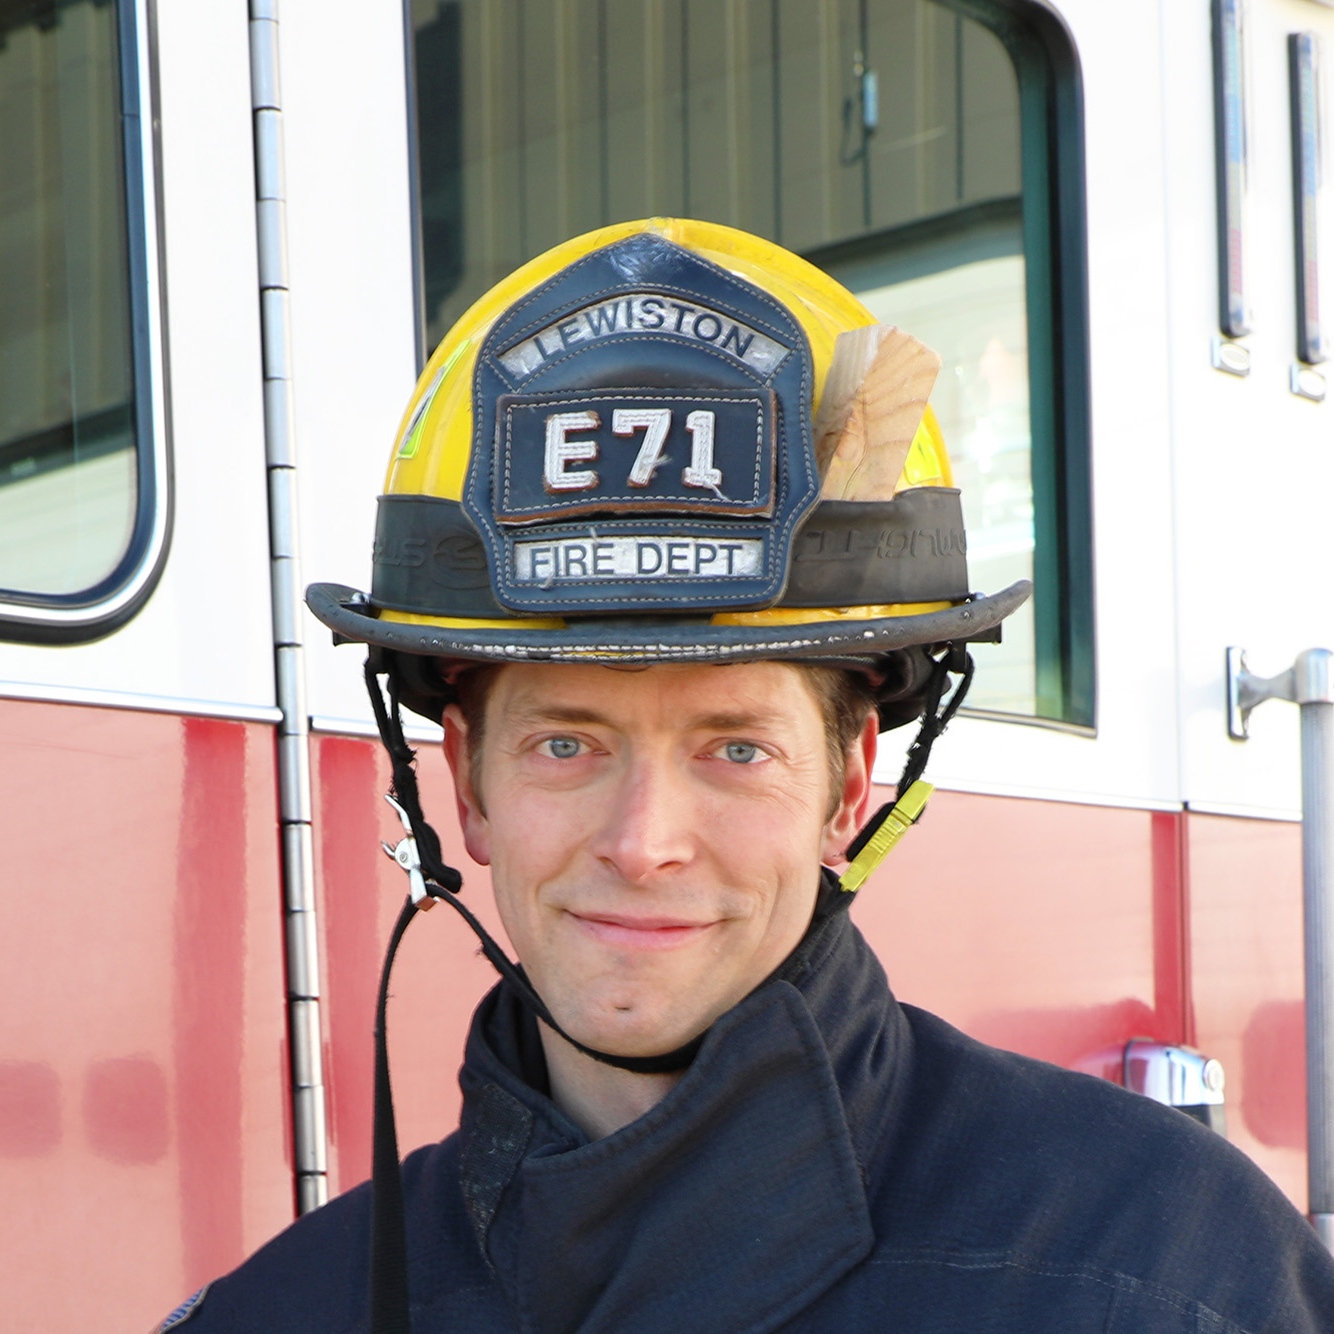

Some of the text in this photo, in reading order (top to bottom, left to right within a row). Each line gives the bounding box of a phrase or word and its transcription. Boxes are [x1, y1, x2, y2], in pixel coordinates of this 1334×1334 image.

[533, 298, 757, 362] LEWISTON
[543, 408, 723, 493] E71
[529, 540, 743, 580] FIRE DEPT
